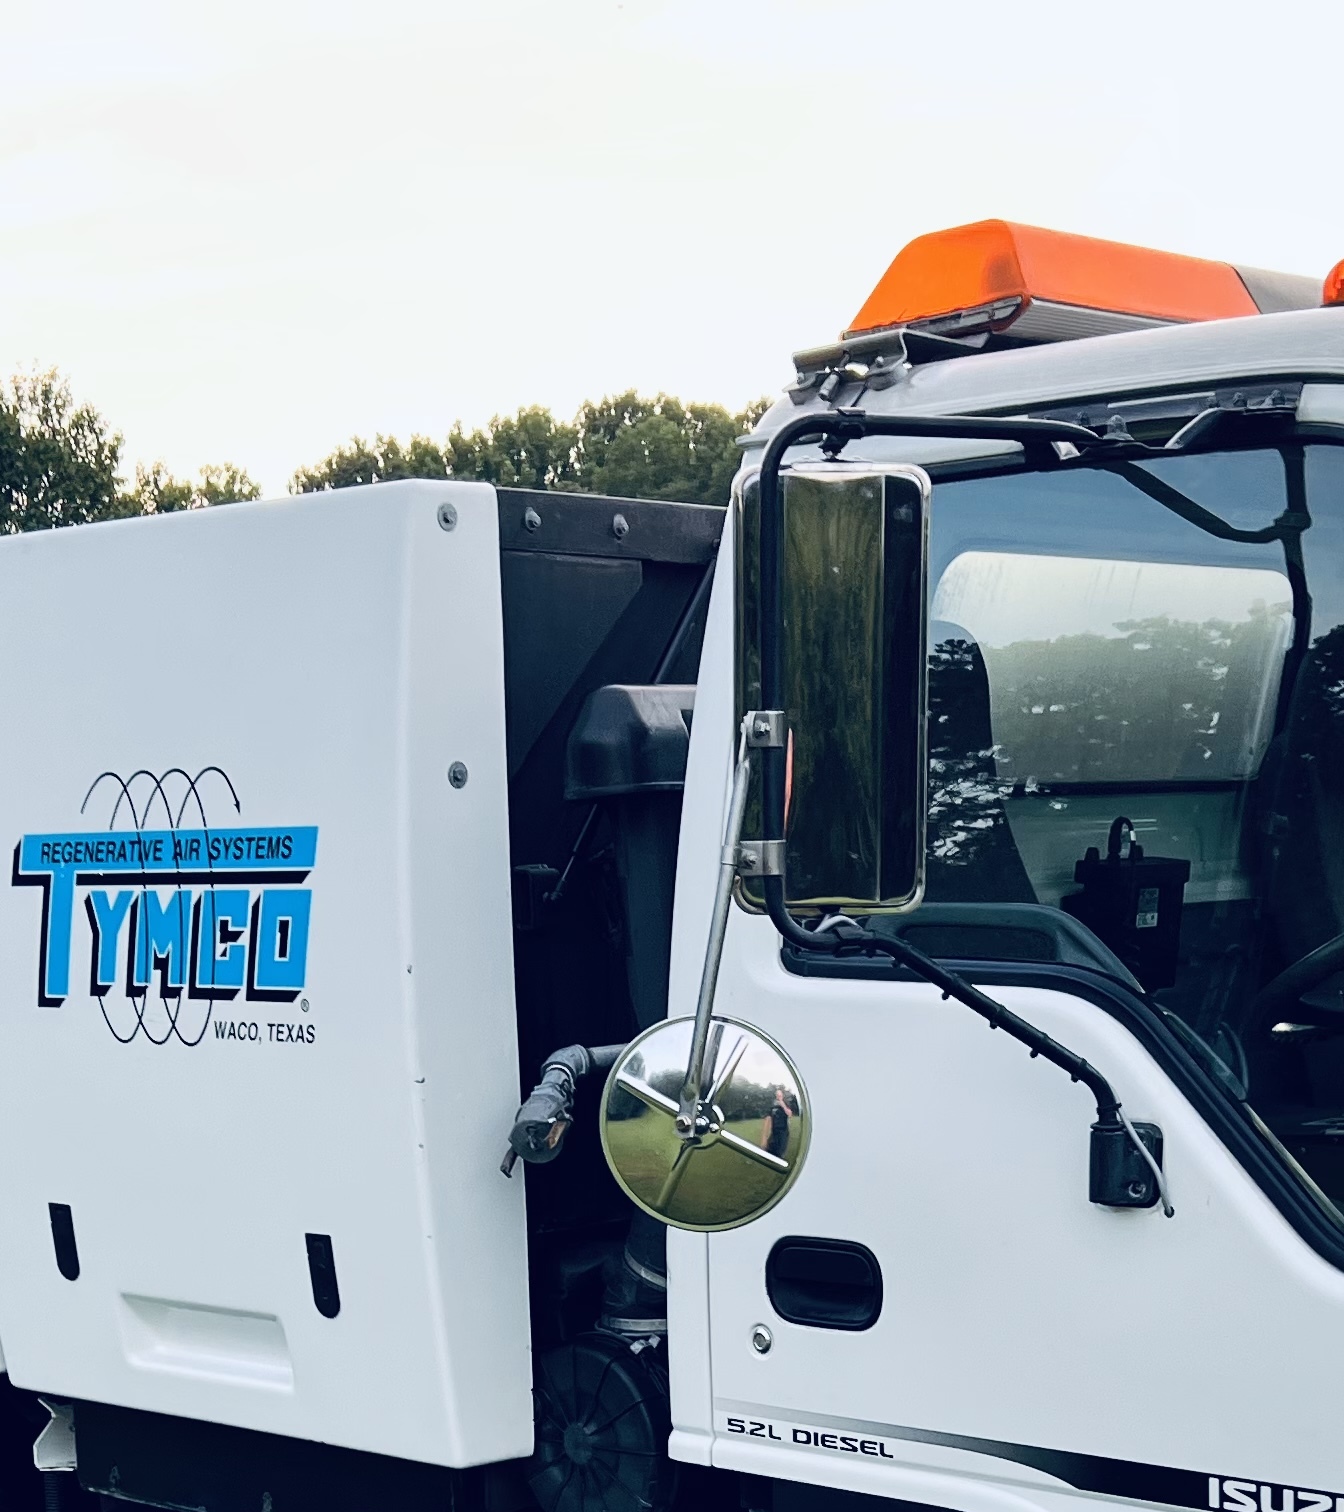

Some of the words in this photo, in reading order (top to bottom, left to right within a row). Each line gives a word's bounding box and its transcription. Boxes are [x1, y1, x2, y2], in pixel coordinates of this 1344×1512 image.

[40, 838, 164, 865] REGENERATIVE
[172, 837, 201, 860] AIR
[209, 835, 293, 861] SYSTEMS
[11, 826, 319, 1007] TYMCO
[214, 1020, 262, 1045] WACO,
[267, 1022, 316, 1044] TEXAS
[727, 1417, 782, 1441] 5.2L
[792, 1428, 894, 1459] DIESEL
